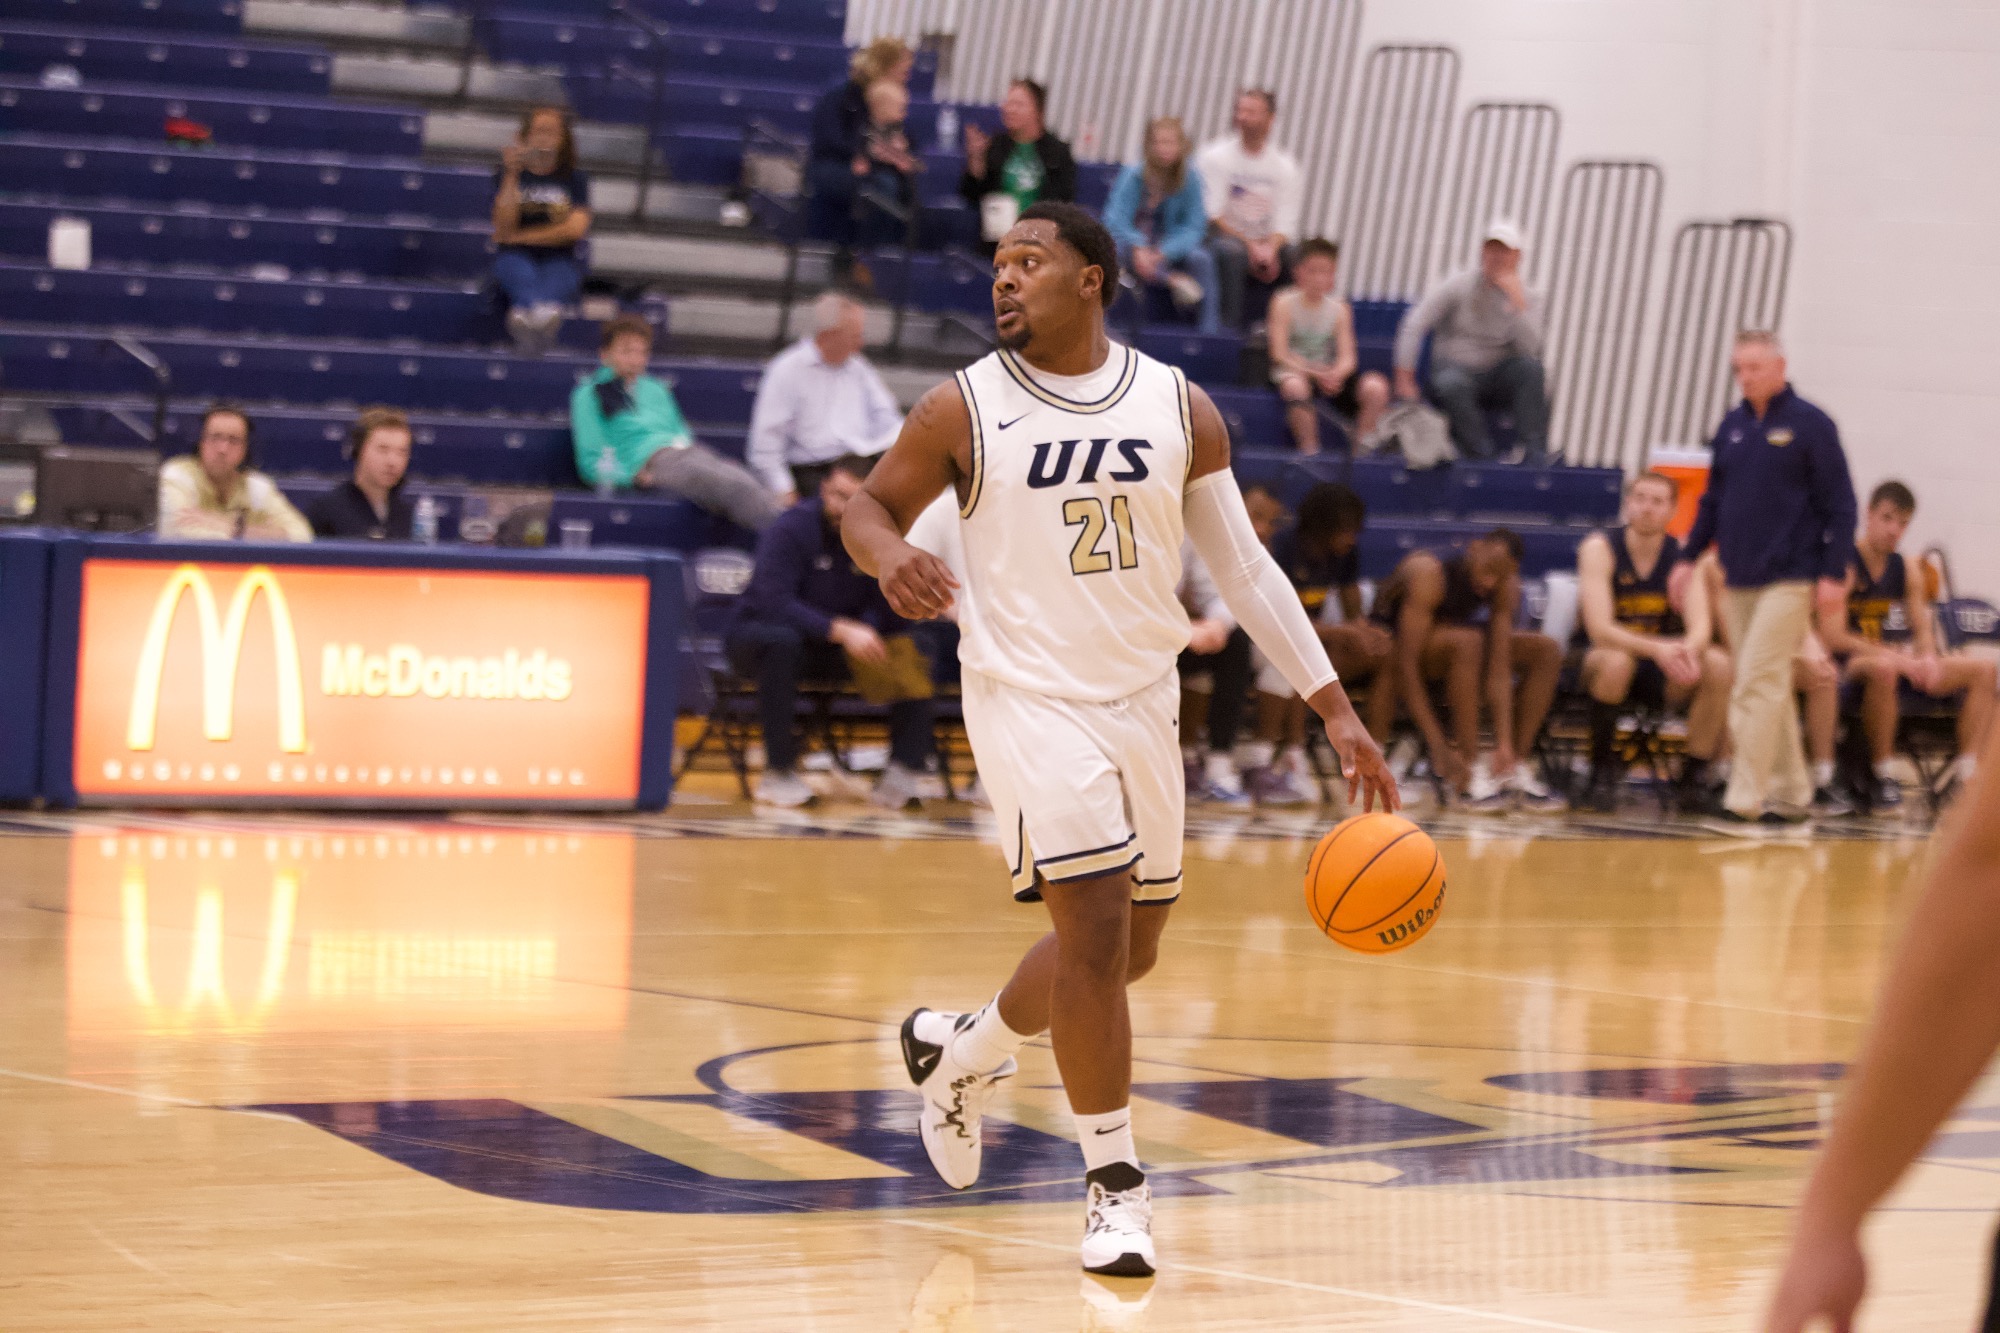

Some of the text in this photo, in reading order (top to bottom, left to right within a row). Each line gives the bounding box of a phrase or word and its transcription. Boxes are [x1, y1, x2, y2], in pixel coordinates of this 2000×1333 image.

[1027, 438, 1154, 489] UIS
[1062, 495, 1139, 576] 21
[322, 644, 572, 700] McDonalds
[1375, 880, 1447, 946] Wilson
